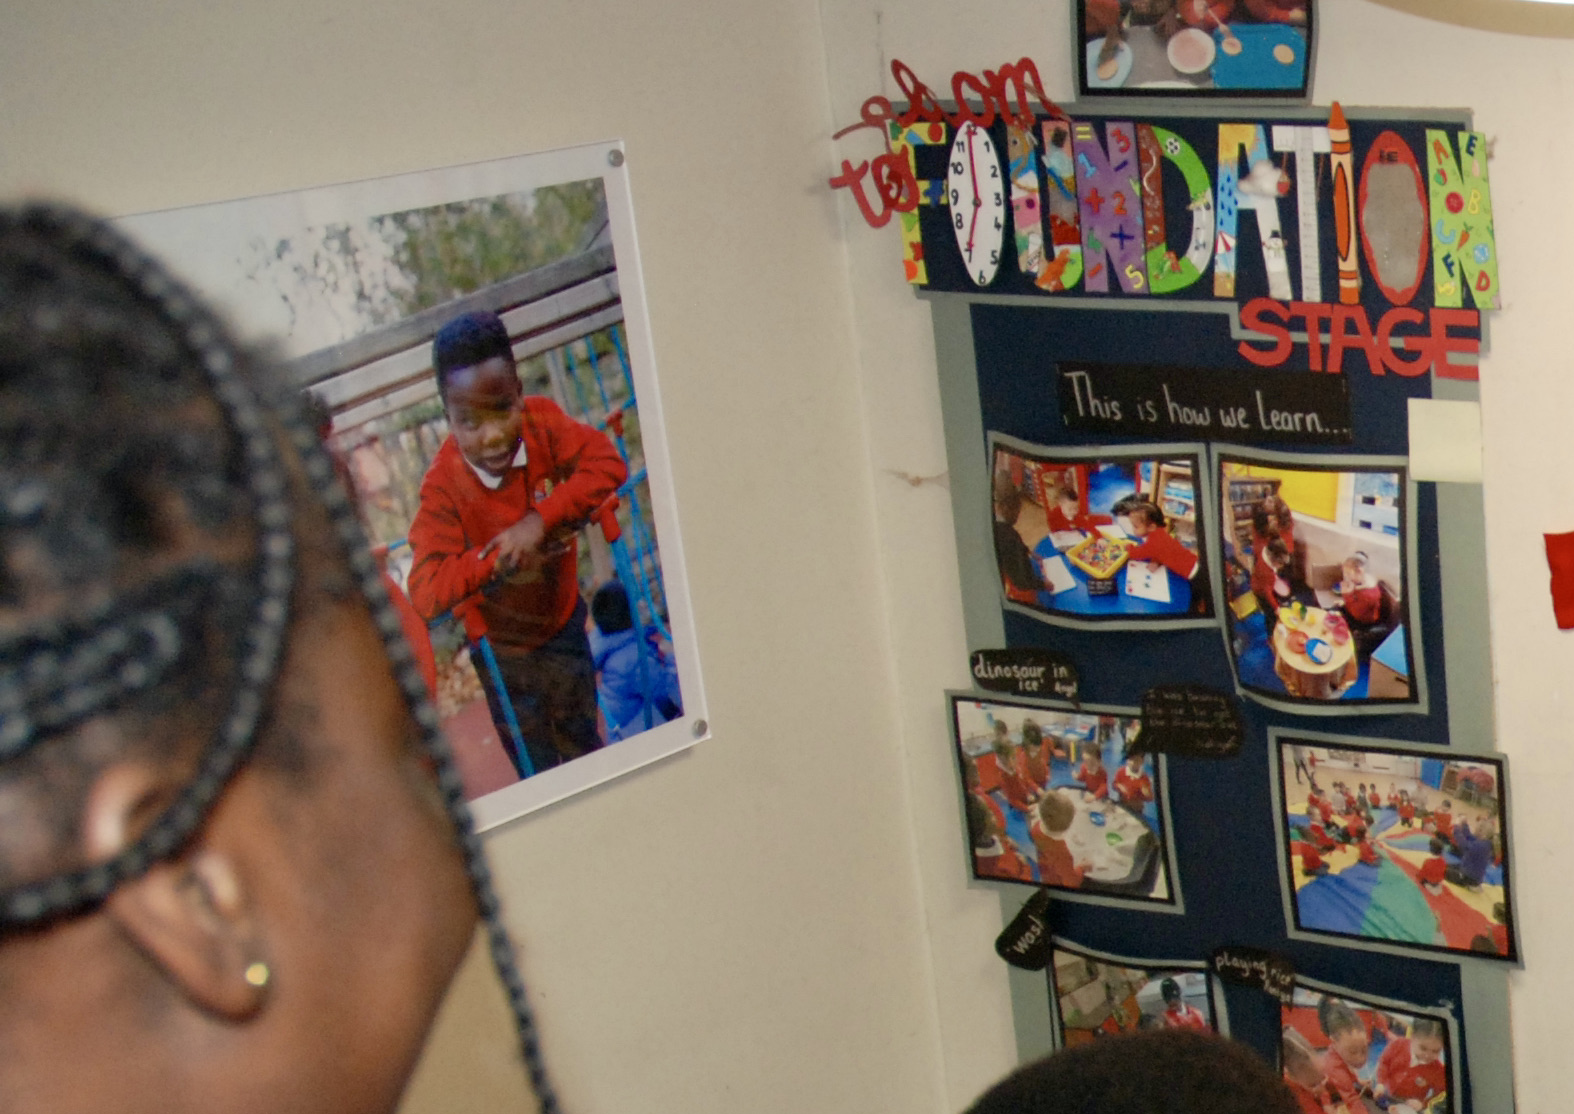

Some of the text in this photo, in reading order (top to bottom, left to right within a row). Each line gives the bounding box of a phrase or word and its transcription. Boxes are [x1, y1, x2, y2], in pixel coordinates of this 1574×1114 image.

[1237, 297, 1480, 380] STAGE
[1064, 370, 1122, 421] This
[1136, 396, 1158, 422] is
[1162, 383, 1212, 426] how
[1219, 406, 1250, 430] we
[974, 653, 1068, 679] dinosaur in
